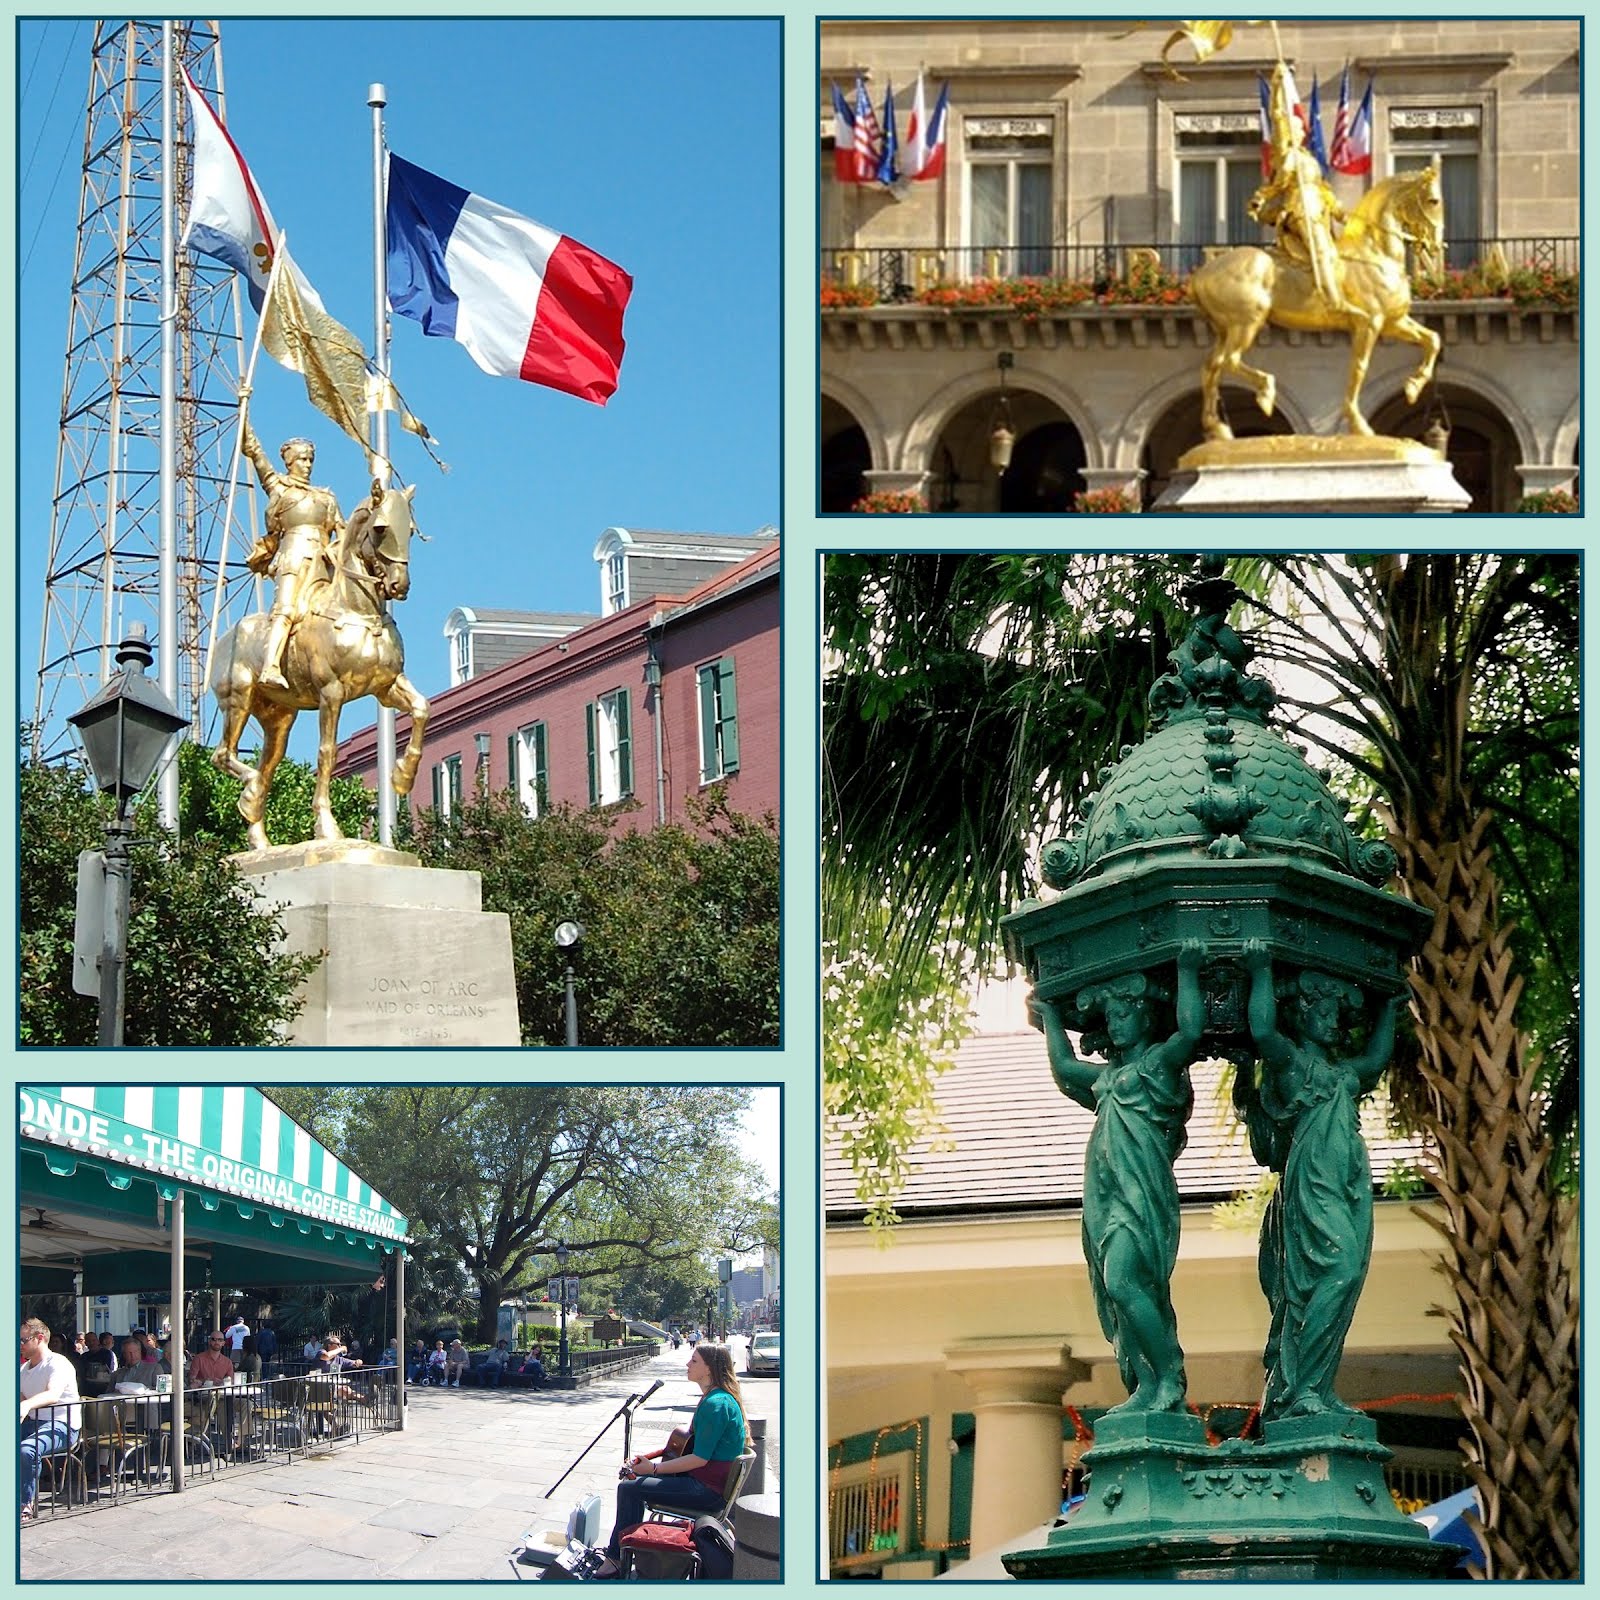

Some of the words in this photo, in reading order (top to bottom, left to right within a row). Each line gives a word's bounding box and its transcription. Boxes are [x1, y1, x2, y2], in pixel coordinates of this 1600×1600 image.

[368, 977, 410, 992] JOAN
[448, 982, 479, 997] ARC
[366, 1001, 398, 1014] MAID
[426, 1003, 484, 1018] ORLEANS
[142, 1133, 197, 1171] THE
[202, 1154, 298, 1202] ORIGINAL
[302, 1188, 357, 1221] COFFEE
[359, 1207, 395, 1232] STAND
